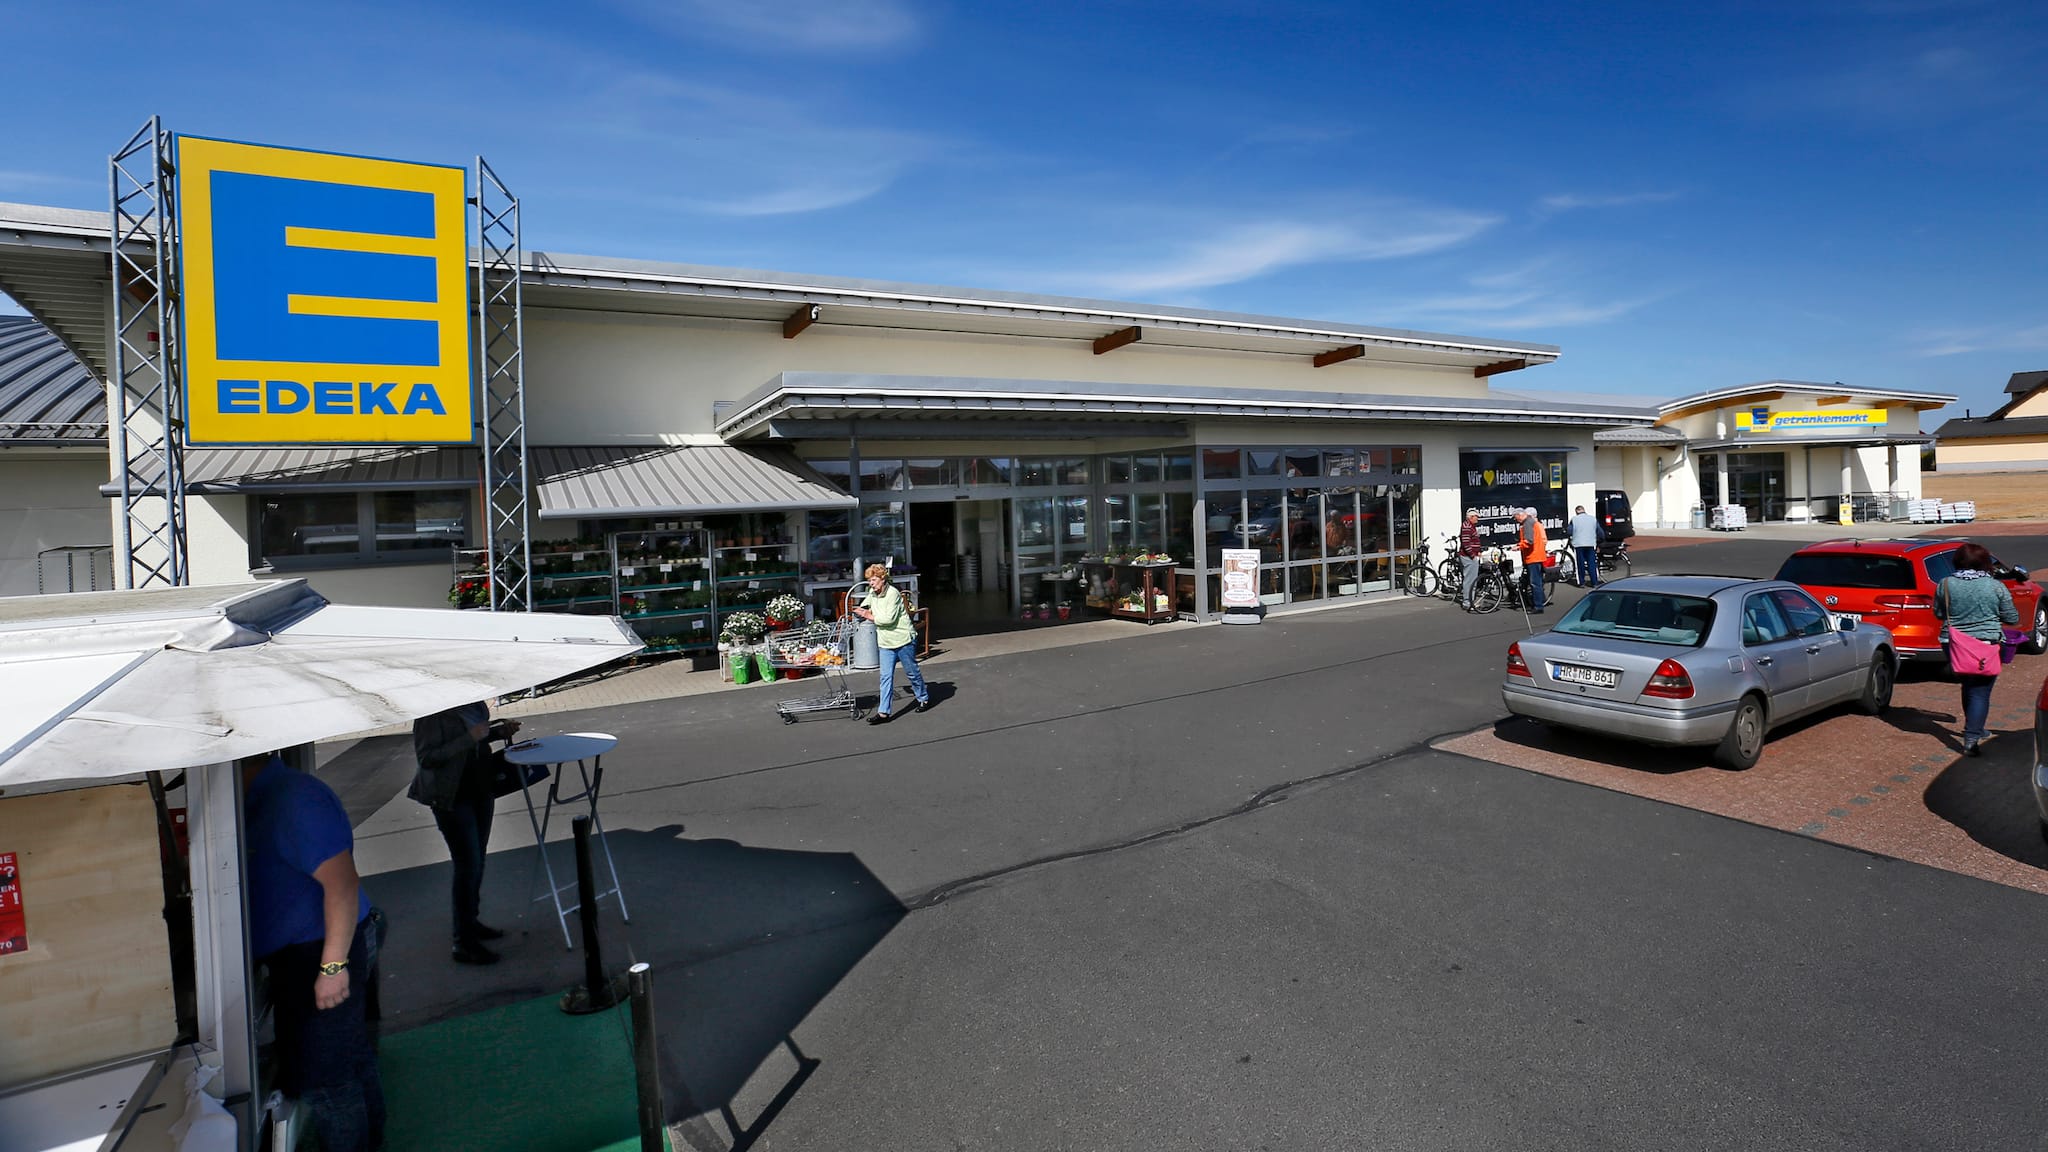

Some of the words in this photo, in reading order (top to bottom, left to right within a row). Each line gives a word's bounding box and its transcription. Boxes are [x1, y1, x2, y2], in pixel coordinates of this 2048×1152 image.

[217, 379, 447, 415] EDEKA
[1775, 414, 1868, 425] getränkemarkt
[1468, 470, 1482, 486] Wir
[1493, 523, 1516, 534] Samstag
[1560, 665, 1572, 677] HR
[1579, 669, 1592, 680] MB
[1595, 671, 1612, 683] 861
